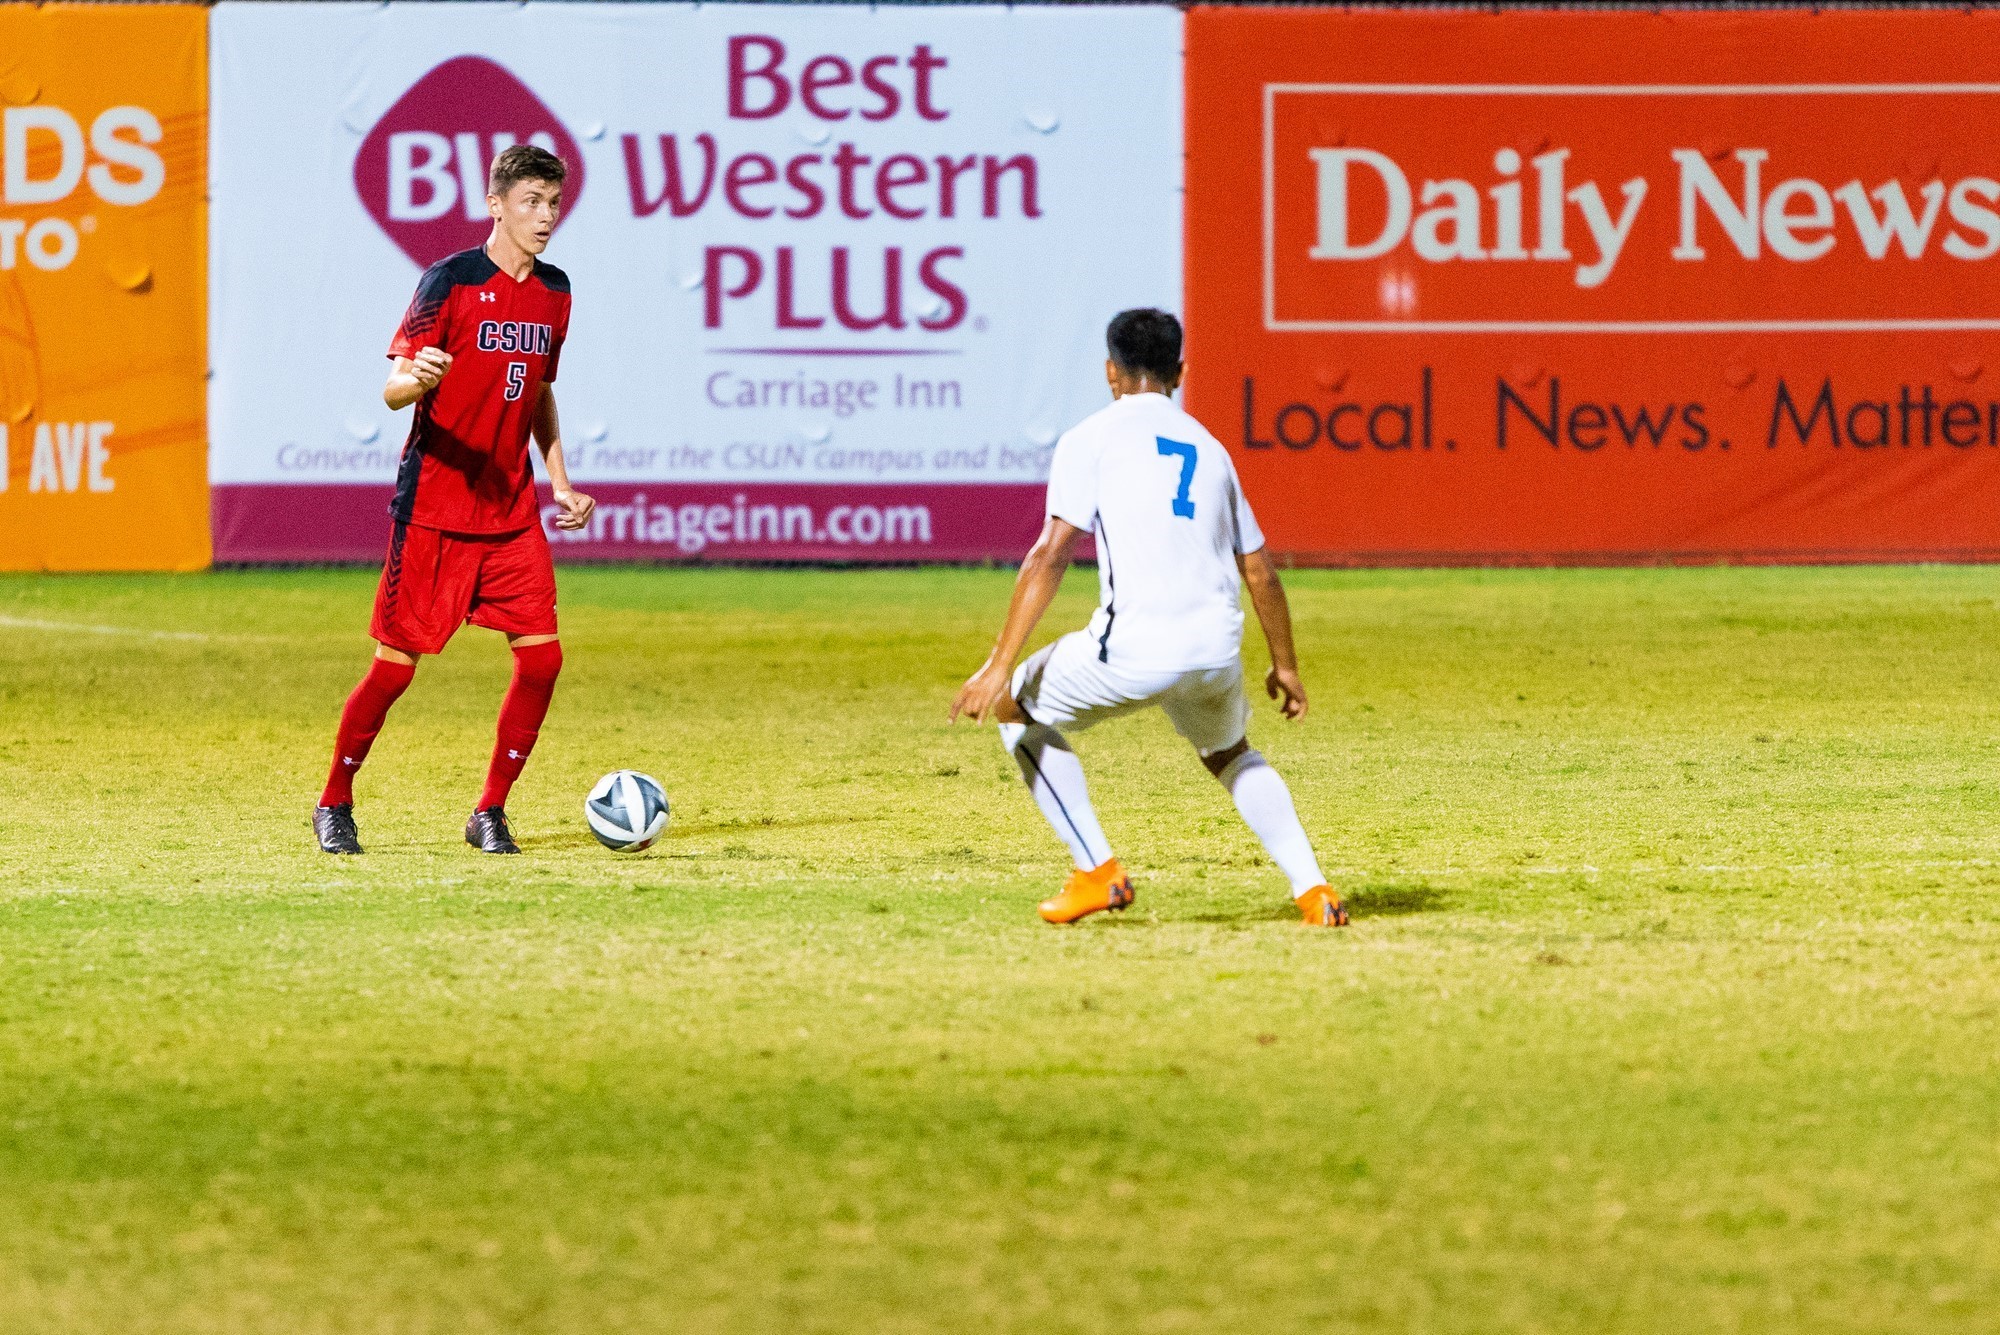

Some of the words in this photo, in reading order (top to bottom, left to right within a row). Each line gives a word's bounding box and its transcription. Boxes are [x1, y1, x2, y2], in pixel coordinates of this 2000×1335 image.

[727, 34, 950, 121] Best
[3, 104, 166, 207] DS
[620, 132, 1044, 220] Western
[1308, 147, 1649, 288] Daily
[1671, 148, 2000, 261] News
[703, 245, 969, 332] PLUS
[477, 320, 552, 355] CSUN
[504, 361, 527, 401] 5
[705, 369, 878, 419] Carriage
[896, 373, 963, 408] Inn
[1242, 366, 1457, 453] Local.
[1497, 376, 1731, 453] News.
[29, 421, 115, 493] AVE
[592, 447, 657, 469] near
[669, 442, 714, 469] the
[721, 442, 804, 470] CSUN
[814, 448, 924, 476] campus
[932, 442, 989, 469] and
[1155, 435, 1197, 520] 7
